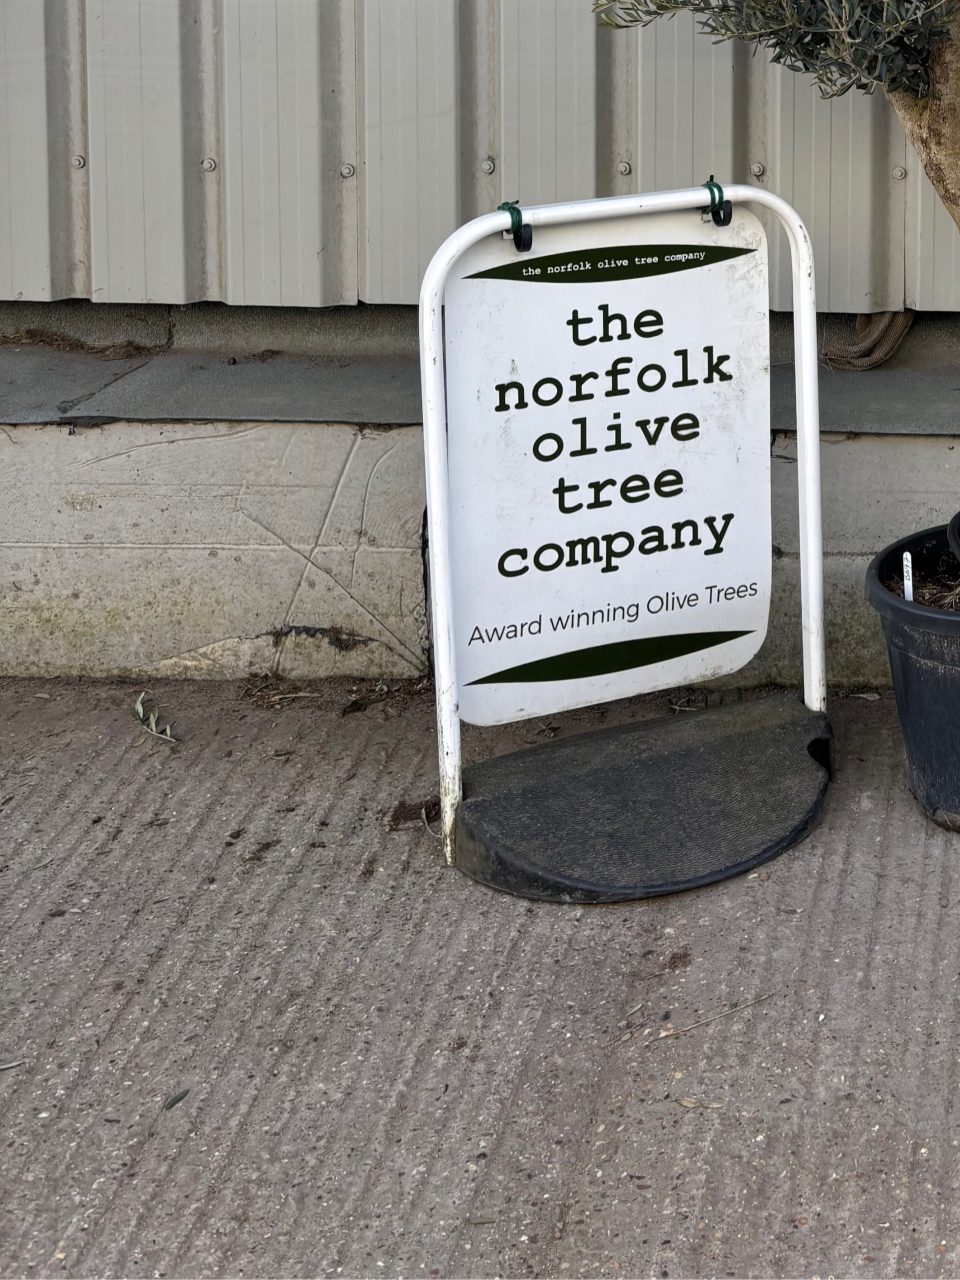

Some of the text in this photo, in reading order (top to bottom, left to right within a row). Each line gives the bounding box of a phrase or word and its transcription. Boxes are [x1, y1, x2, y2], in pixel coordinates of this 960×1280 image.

[522, 251, 706, 276] the norfolk olive tree company
[566, 303, 664, 347] the
[494, 345, 733, 413] norfolk
[532, 411, 700, 463] olive
[552, 468, 684, 515] tree
[497, 512, 735, 578] company
[467, 582, 758, 646] Award winning Olive Trees
